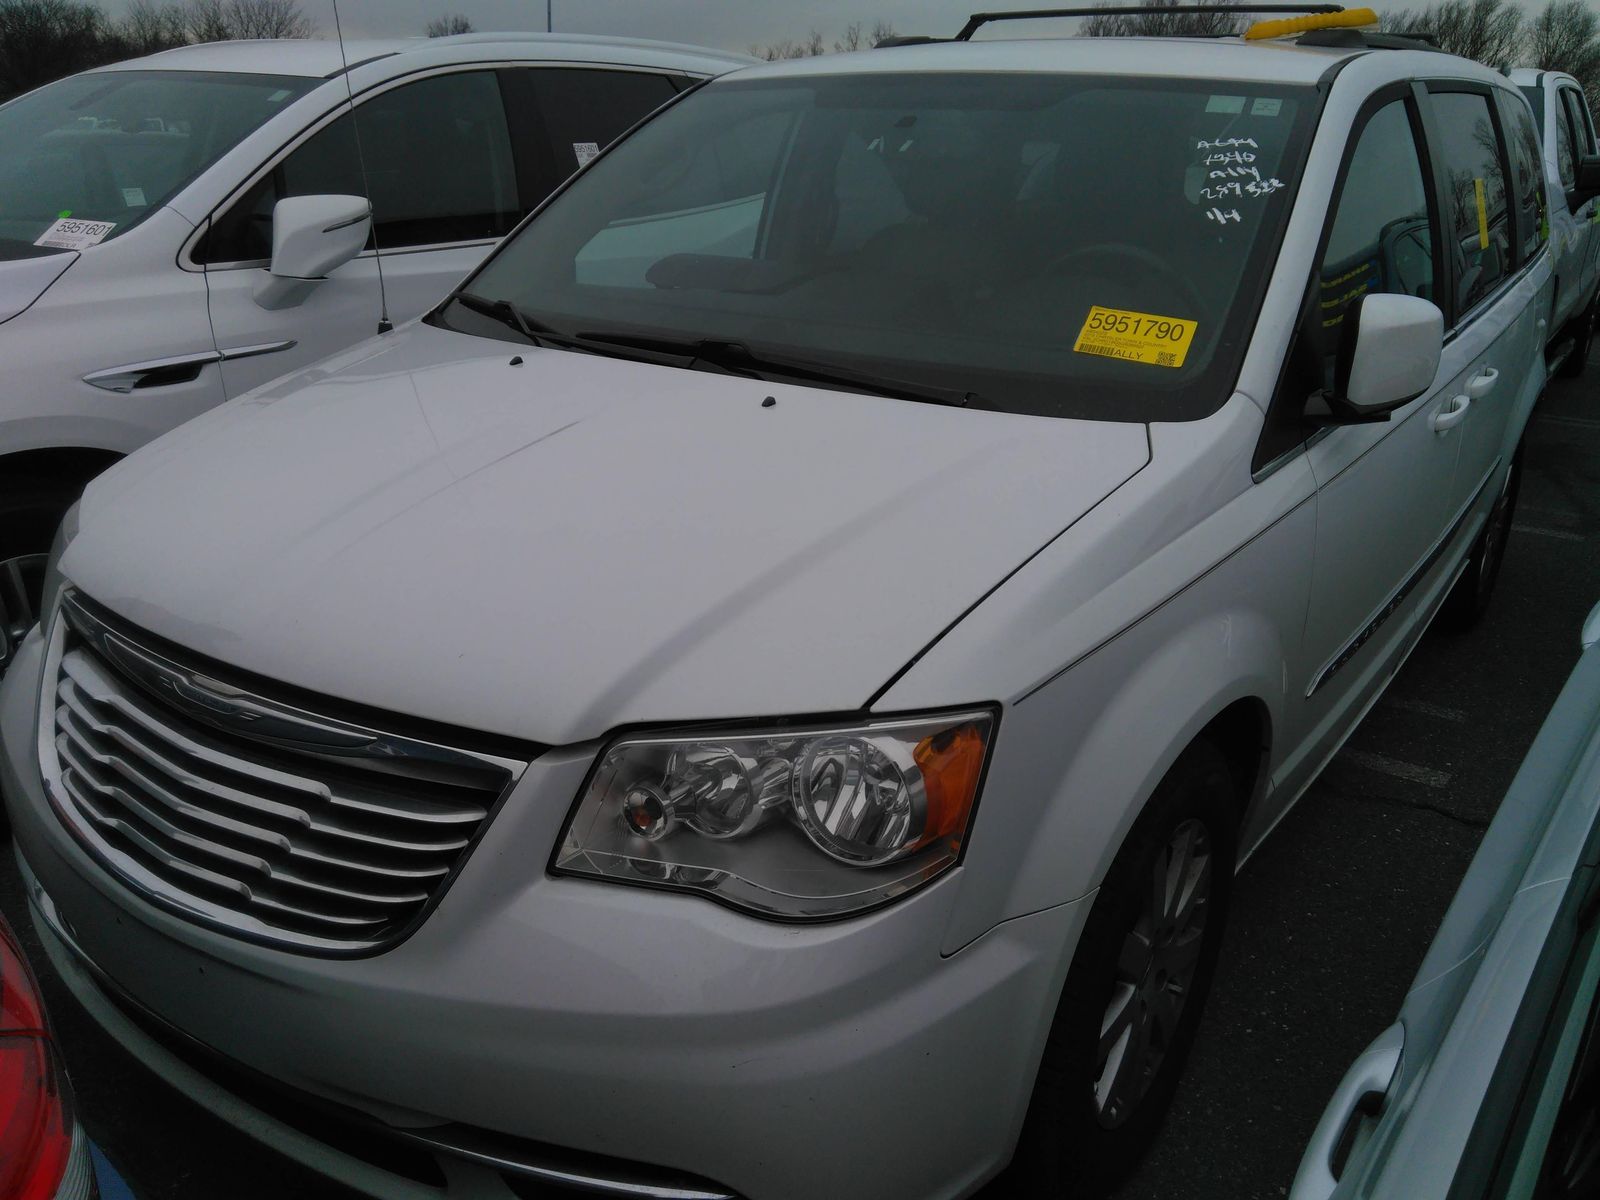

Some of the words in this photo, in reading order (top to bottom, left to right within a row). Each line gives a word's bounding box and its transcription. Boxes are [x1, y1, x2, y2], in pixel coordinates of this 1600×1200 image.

[56, 221, 113, 236] 5951601
[1089, 312, 1185, 342] 5951790
[1114, 349, 1144, 360] ALLY
